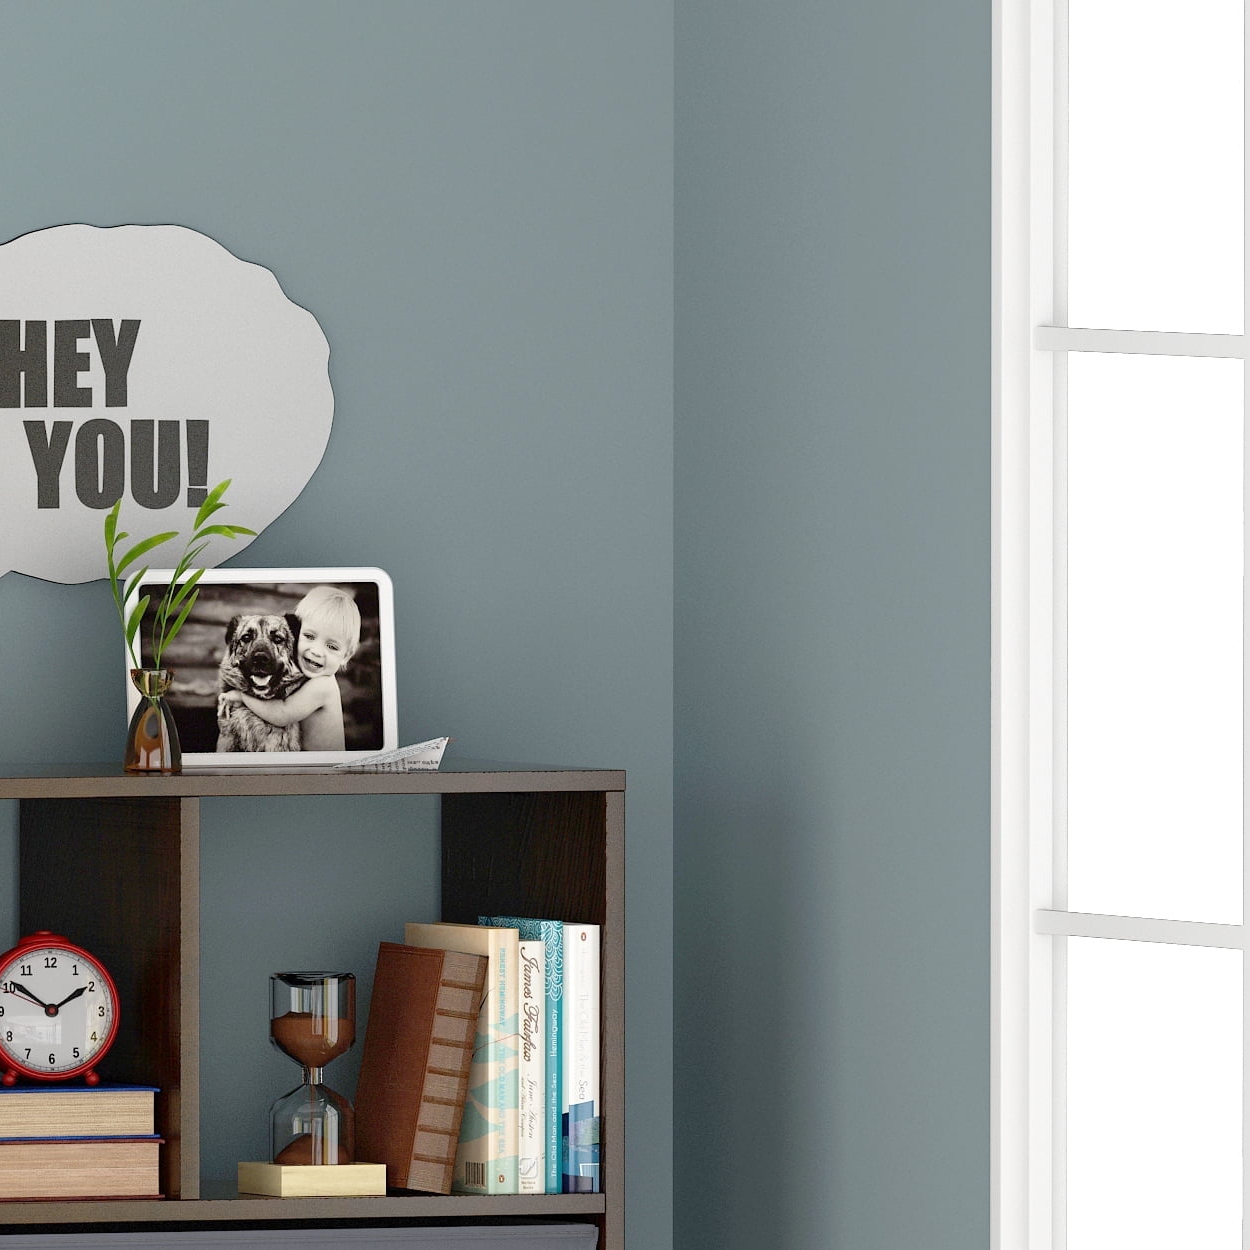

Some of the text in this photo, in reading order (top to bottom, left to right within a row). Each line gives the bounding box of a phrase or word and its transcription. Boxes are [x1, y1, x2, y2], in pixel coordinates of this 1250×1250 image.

[23, 417, 210, 510] YOU!
[44, 957, 57, 969] 12
[20, 965, 33, 976] 11
[72, 965, 79, 976] 1
[3, 982, 16, 994] 10
[88, 981, 95, 992] 2
[520, 947, 540, 1062] James Fairfax
[98, 1006, 105, 1017] 3
[6, 1031, 13, 1042] 8
[90, 1031, 97, 1042] 4
[550, 1008, 558, 1057] Hemingway
[25, 1048, 32, 1059] 7
[72, 1047, 80, 1058] 5
[48, 1053, 55, 1064] 6
[578, 1079, 588, 1100] Sea
